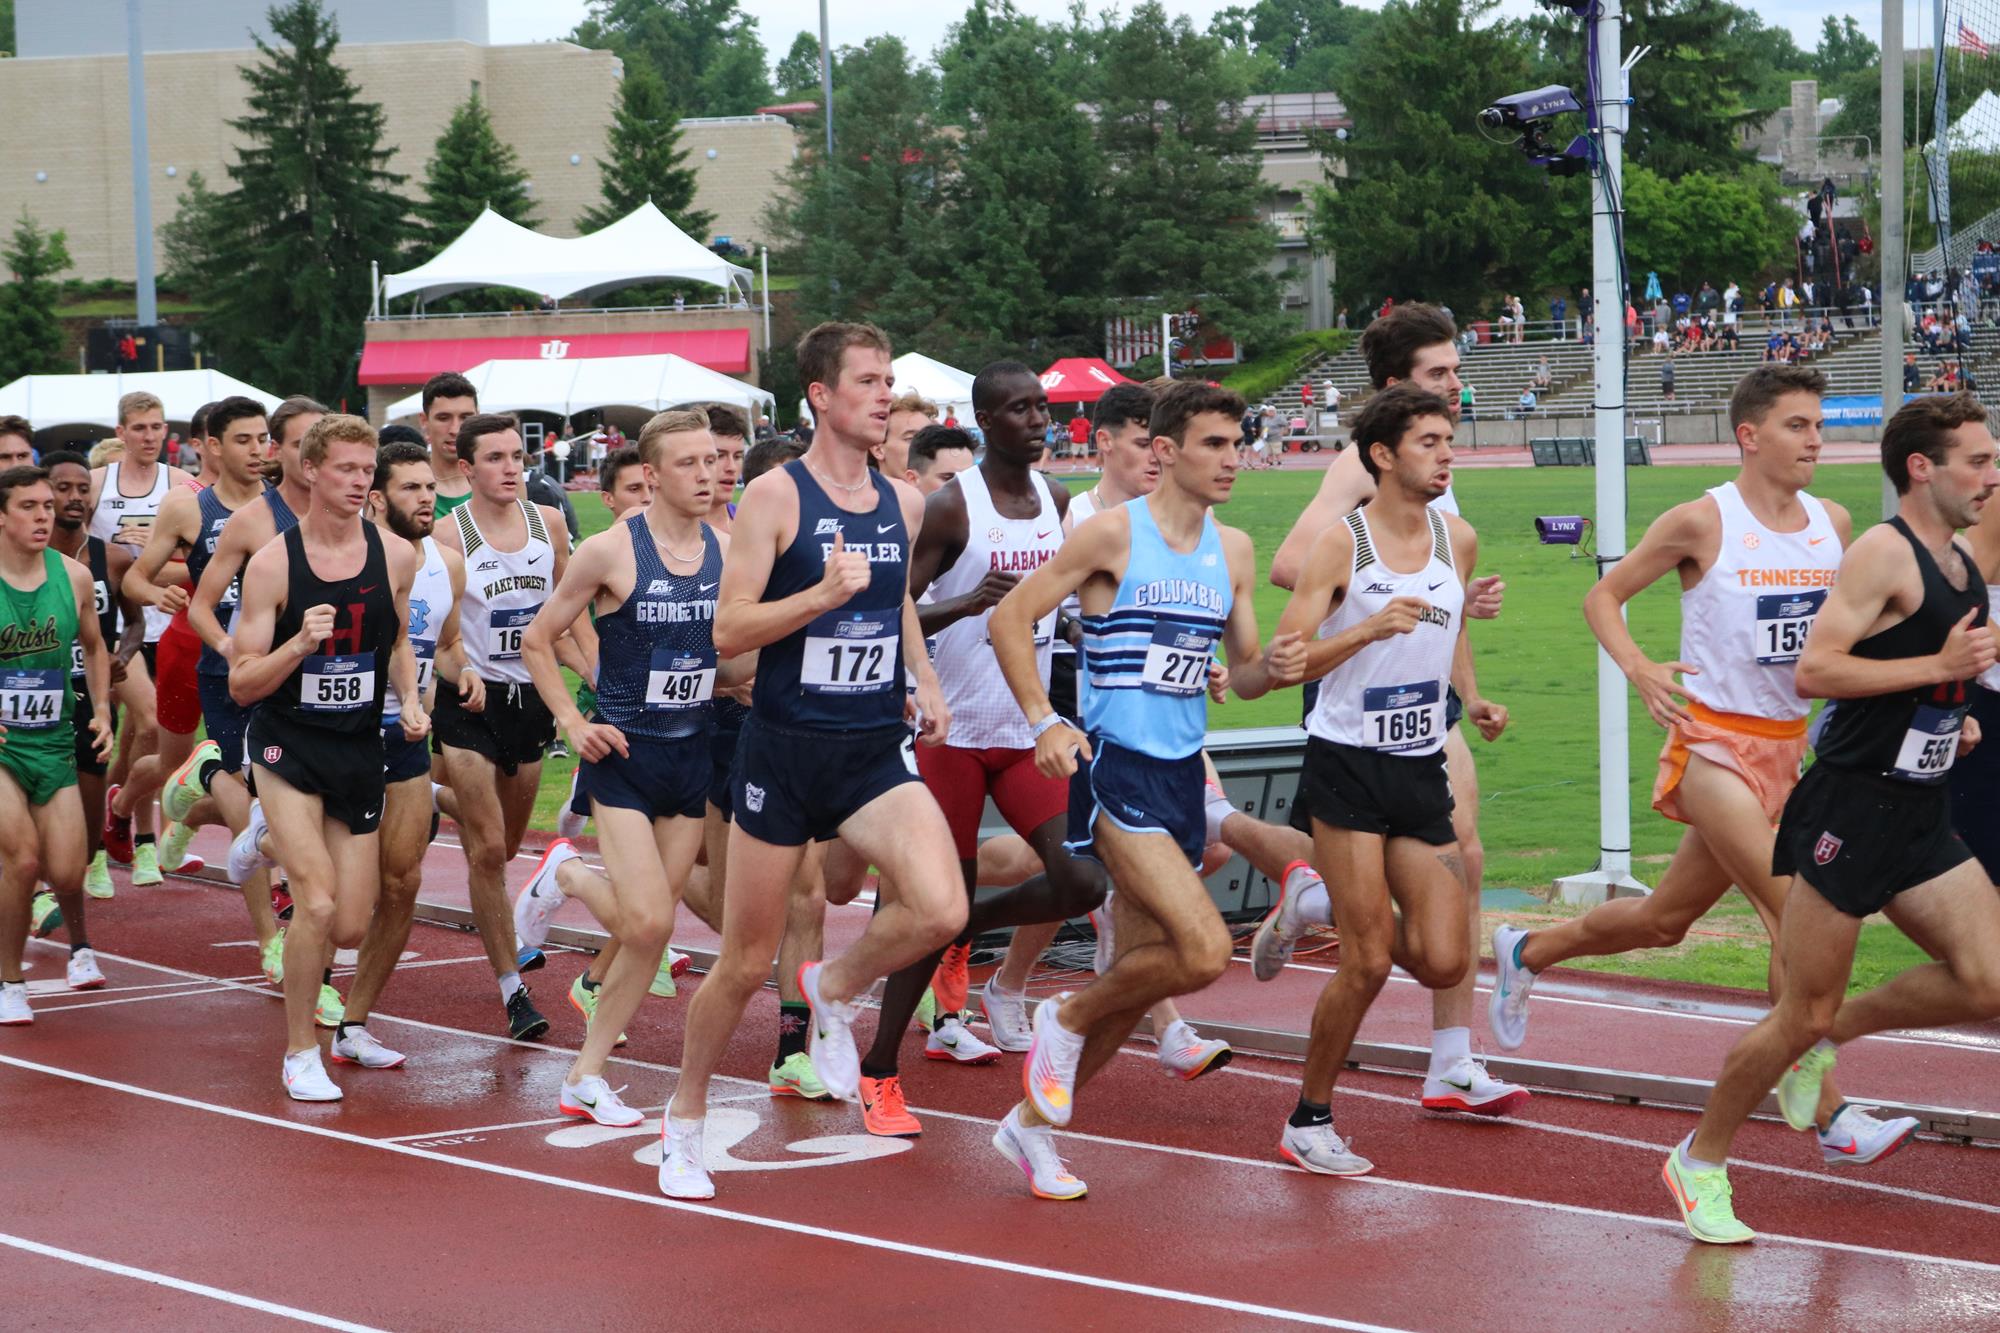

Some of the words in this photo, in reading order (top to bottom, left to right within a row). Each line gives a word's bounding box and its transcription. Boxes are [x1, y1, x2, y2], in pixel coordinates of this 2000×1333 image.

[1543, 99, 1566, 110] LYNX
[1552, 522, 1576, 531] LYNX
[476, 561, 499, 570] ACC
[484, 577, 513, 600] WAKE
[513, 576, 547, 592] FOREST
[1135, 579, 1224, 617] COLUMBIA
[1363, 583, 1394, 593] ACC
[828, 644, 884, 682] 172
[1161, 652, 1206, 685] 277
[317, 676, 361, 702] 558
[662, 673, 703, 701] 497
[1375, 708, 1432, 743] 1695
